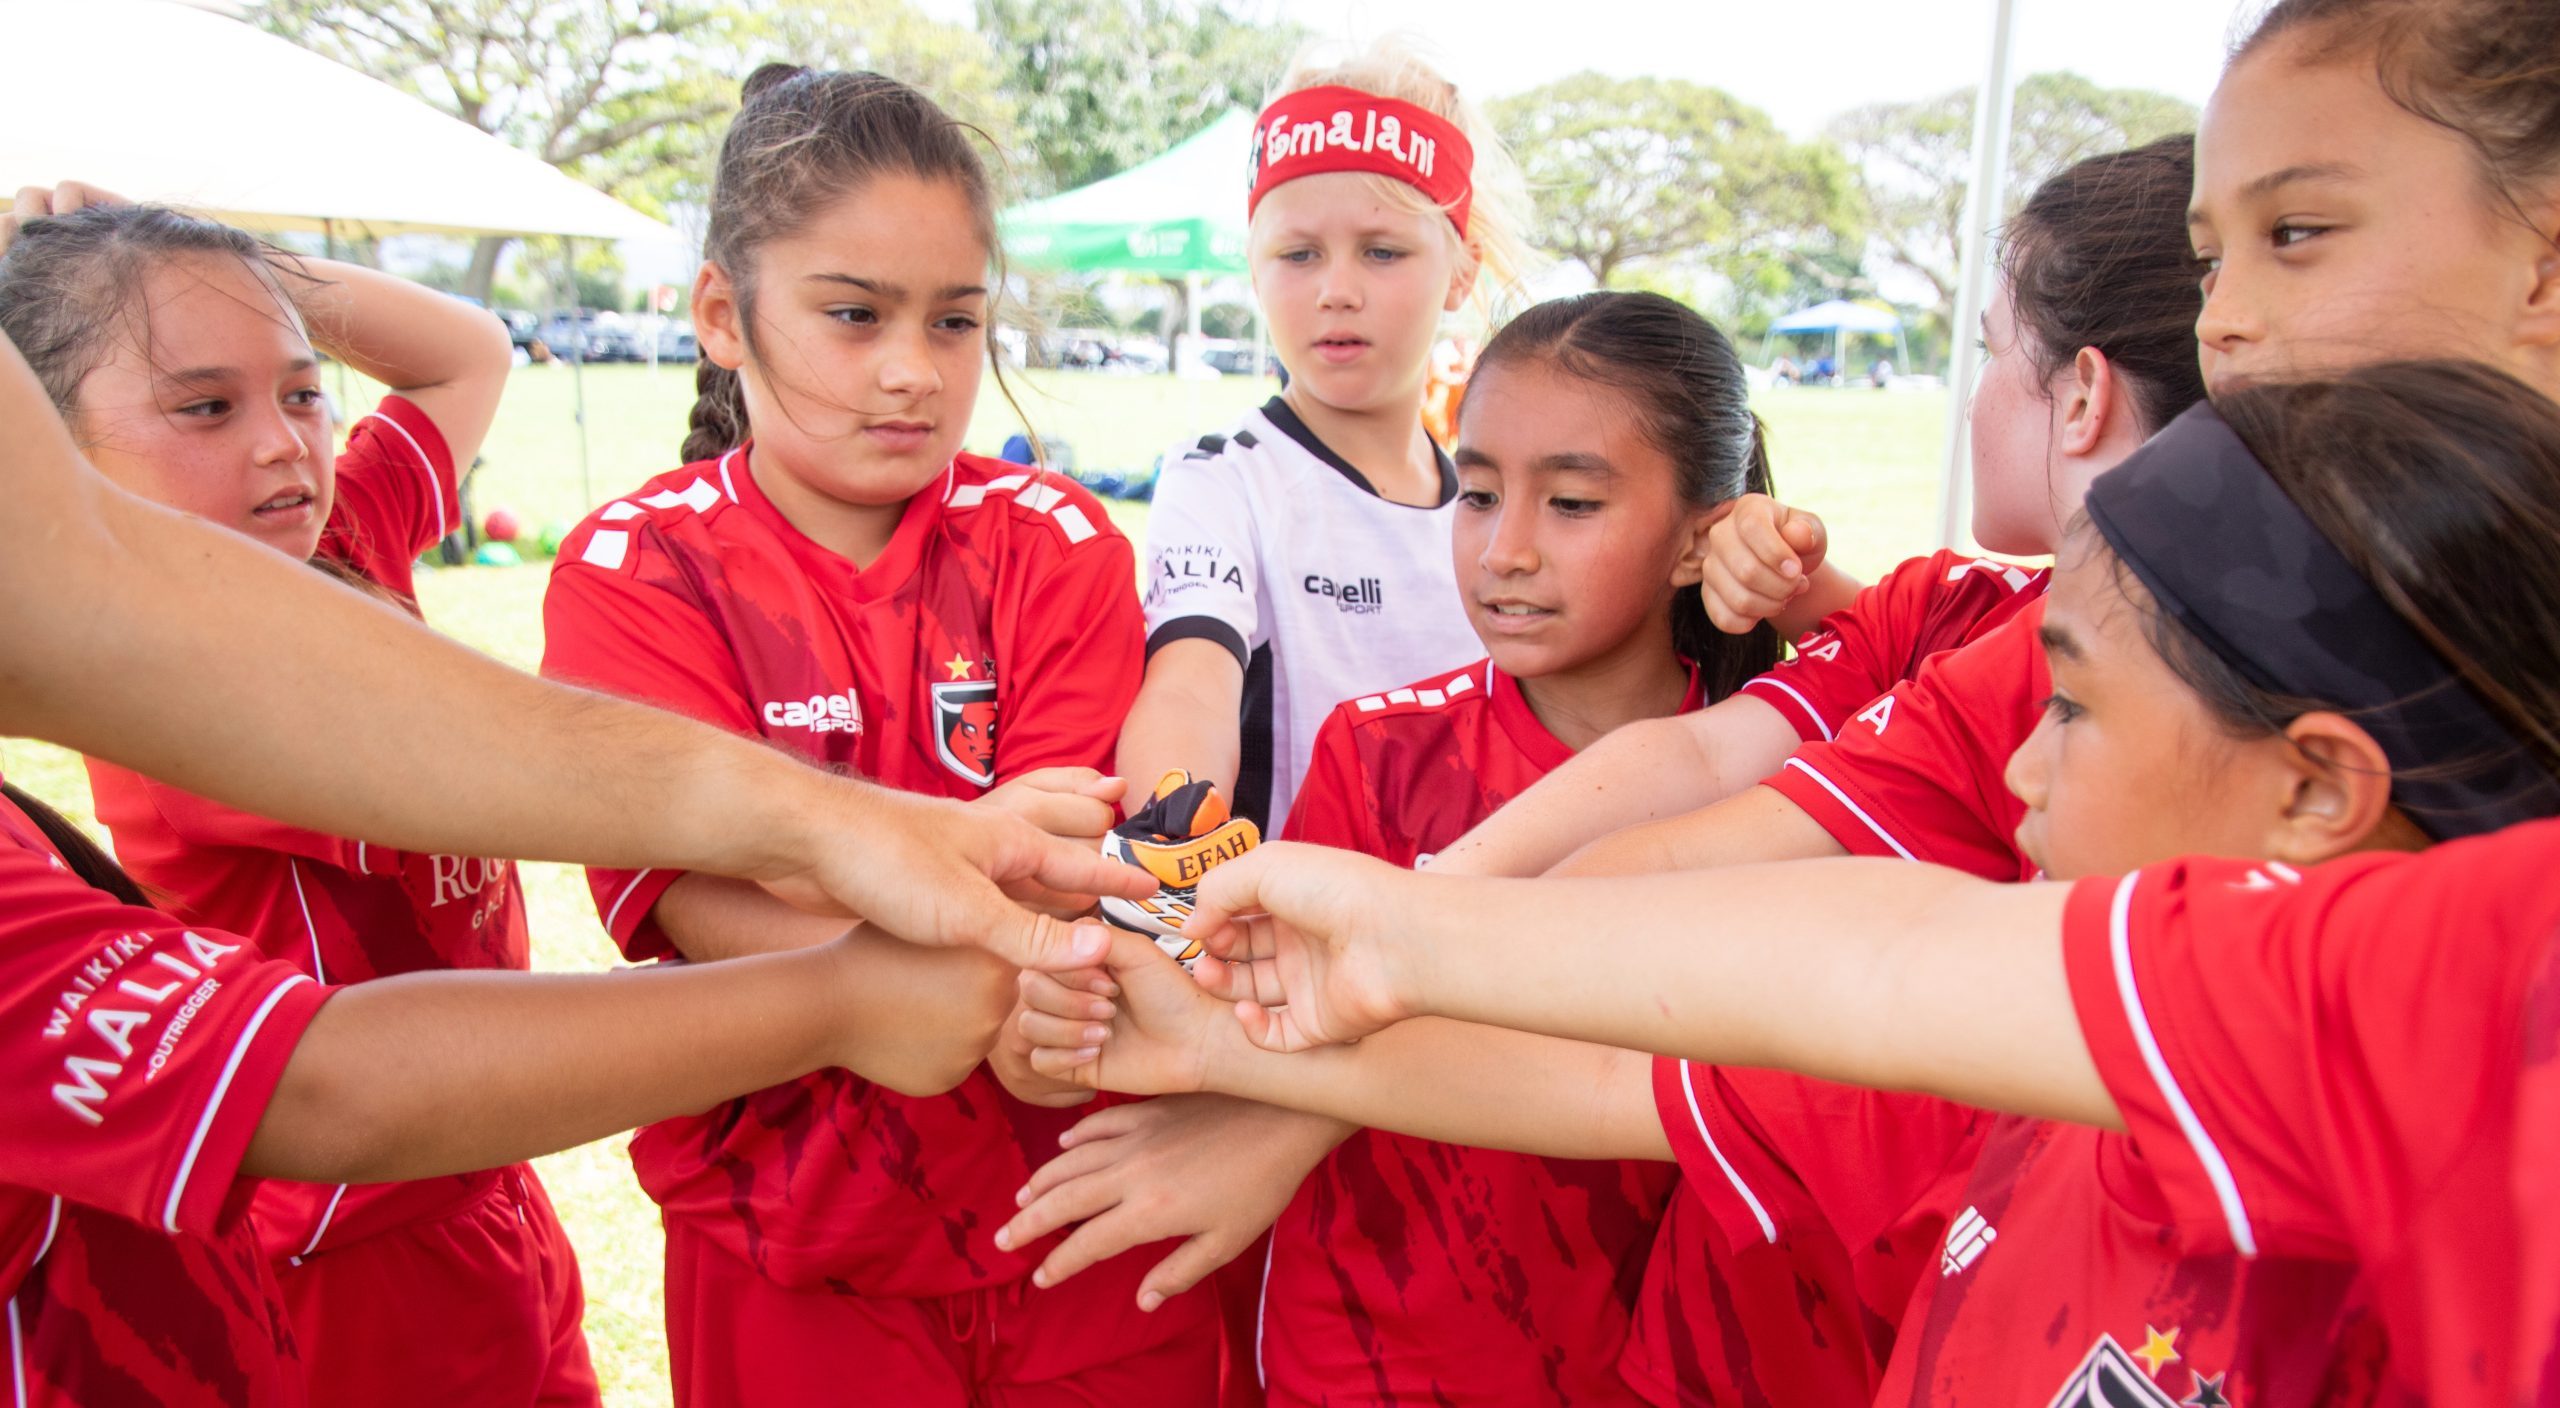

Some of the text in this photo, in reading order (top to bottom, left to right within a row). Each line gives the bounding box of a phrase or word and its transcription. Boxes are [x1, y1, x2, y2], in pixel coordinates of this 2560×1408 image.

[1266, 110, 1436, 178] Emalani
[763, 688, 863, 732] capel
[1176, 832, 1249, 882] EFAH
[43, 932, 154, 1039] WAIKIKI
[149, 977, 222, 1070] OUTRIGGER
[52, 931, 241, 1127] MALIA
